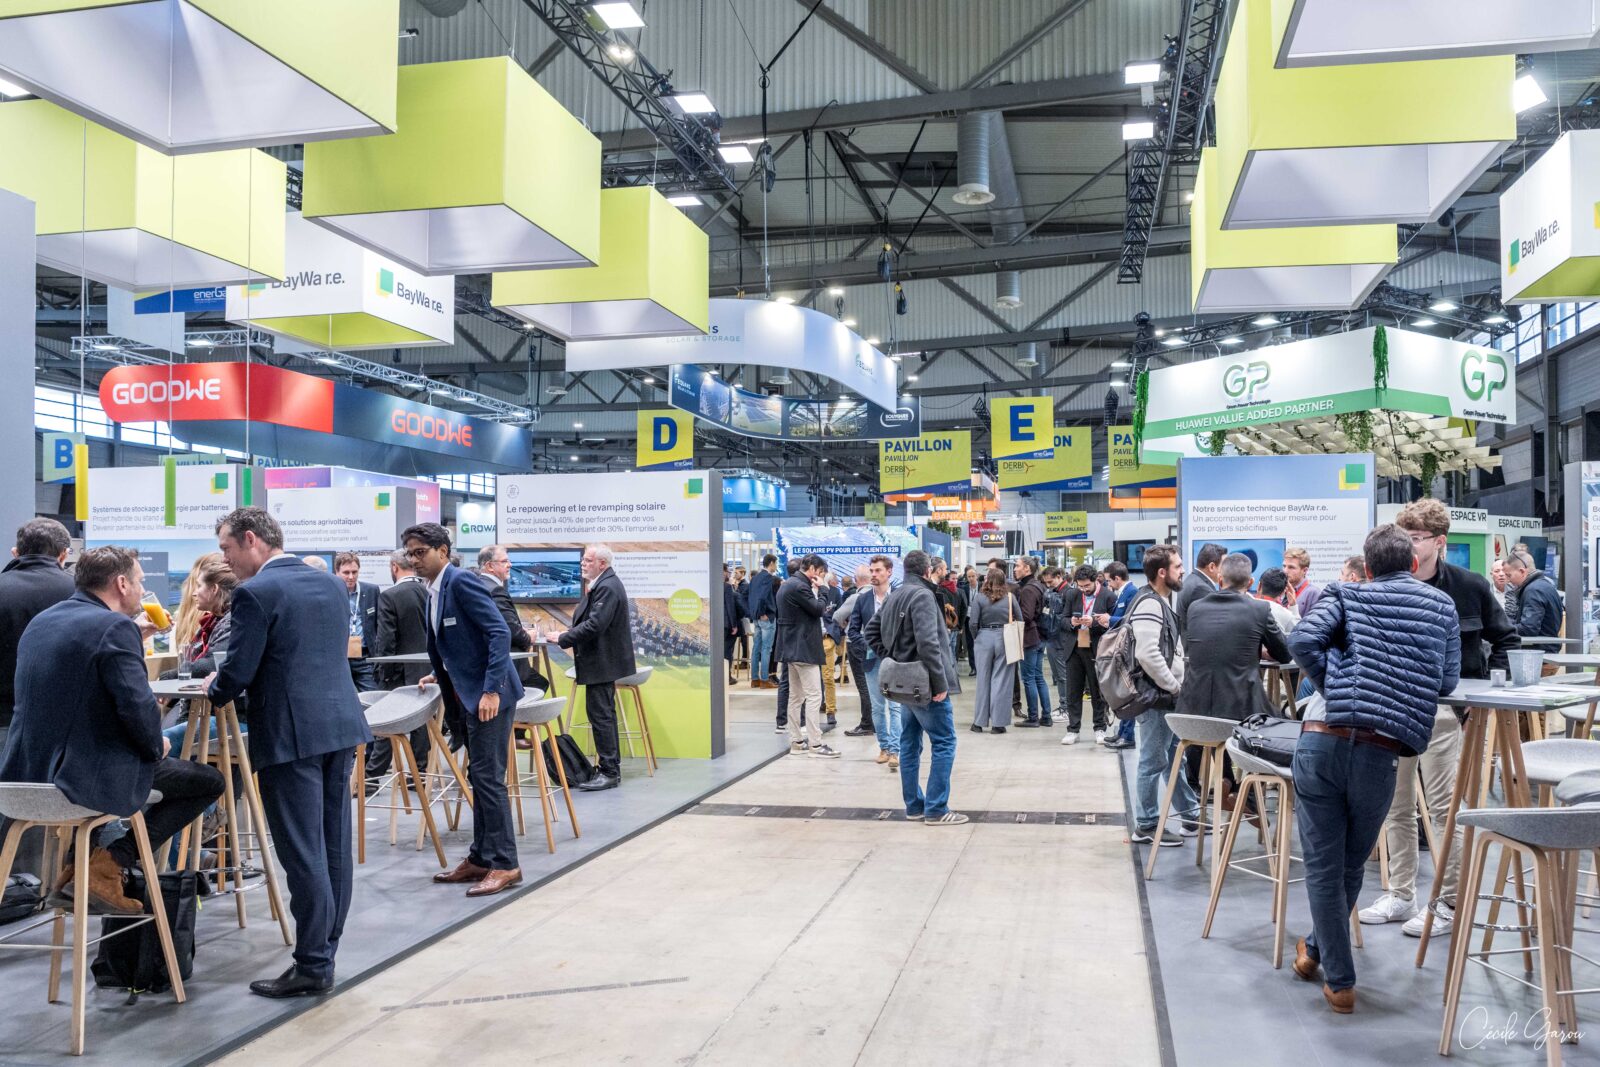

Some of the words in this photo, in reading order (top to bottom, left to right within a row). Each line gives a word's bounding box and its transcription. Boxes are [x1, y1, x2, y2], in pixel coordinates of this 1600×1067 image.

[1522, 227, 1548, 258] BayWa
[1548, 220, 1560, 238] r.e.
[326, 272, 345, 285] r.e.
[397, 282, 430, 308] BayWa
[432, 299, 444, 314] r.e.
[1461, 350, 1508, 402] GP
[112, 378, 220, 405] GOODWE
[1010, 404, 1035, 441] E
[1176, 418, 1212, 432] HUAWEI
[1214, 412, 1245, 426] VALUE
[1246, 407, 1282, 420] ADDED
[1284, 400, 1334, 416] PARTNER
[391, 409, 473, 448] GOODWE
[652, 416, 678, 451] D
[884, 439, 952, 452] PAVILLON
[55, 438, 74, 468] B
[518, 504, 566, 514] repowering
[588, 502, 634, 512] revamping
[636, 502, 666, 510] solaire
[1247, 505, 1286, 513] technique
[1287, 504, 1315, 513] BayWa
[318, 518, 363, 526] agrivoltaïques
[586, 516, 630, 524] performance
[1205, 515, 1273, 523] accompagnement
[1450, 510, 1476, 521] ESPACE
[1477, 512, 1486, 522] VR
[1208, 524, 1233, 533] projets
[1235, 524, 1278, 532] spécifiques
[1498, 518, 1520, 528] ESPACE
[1522, 520, 1541, 529] UTILITY
